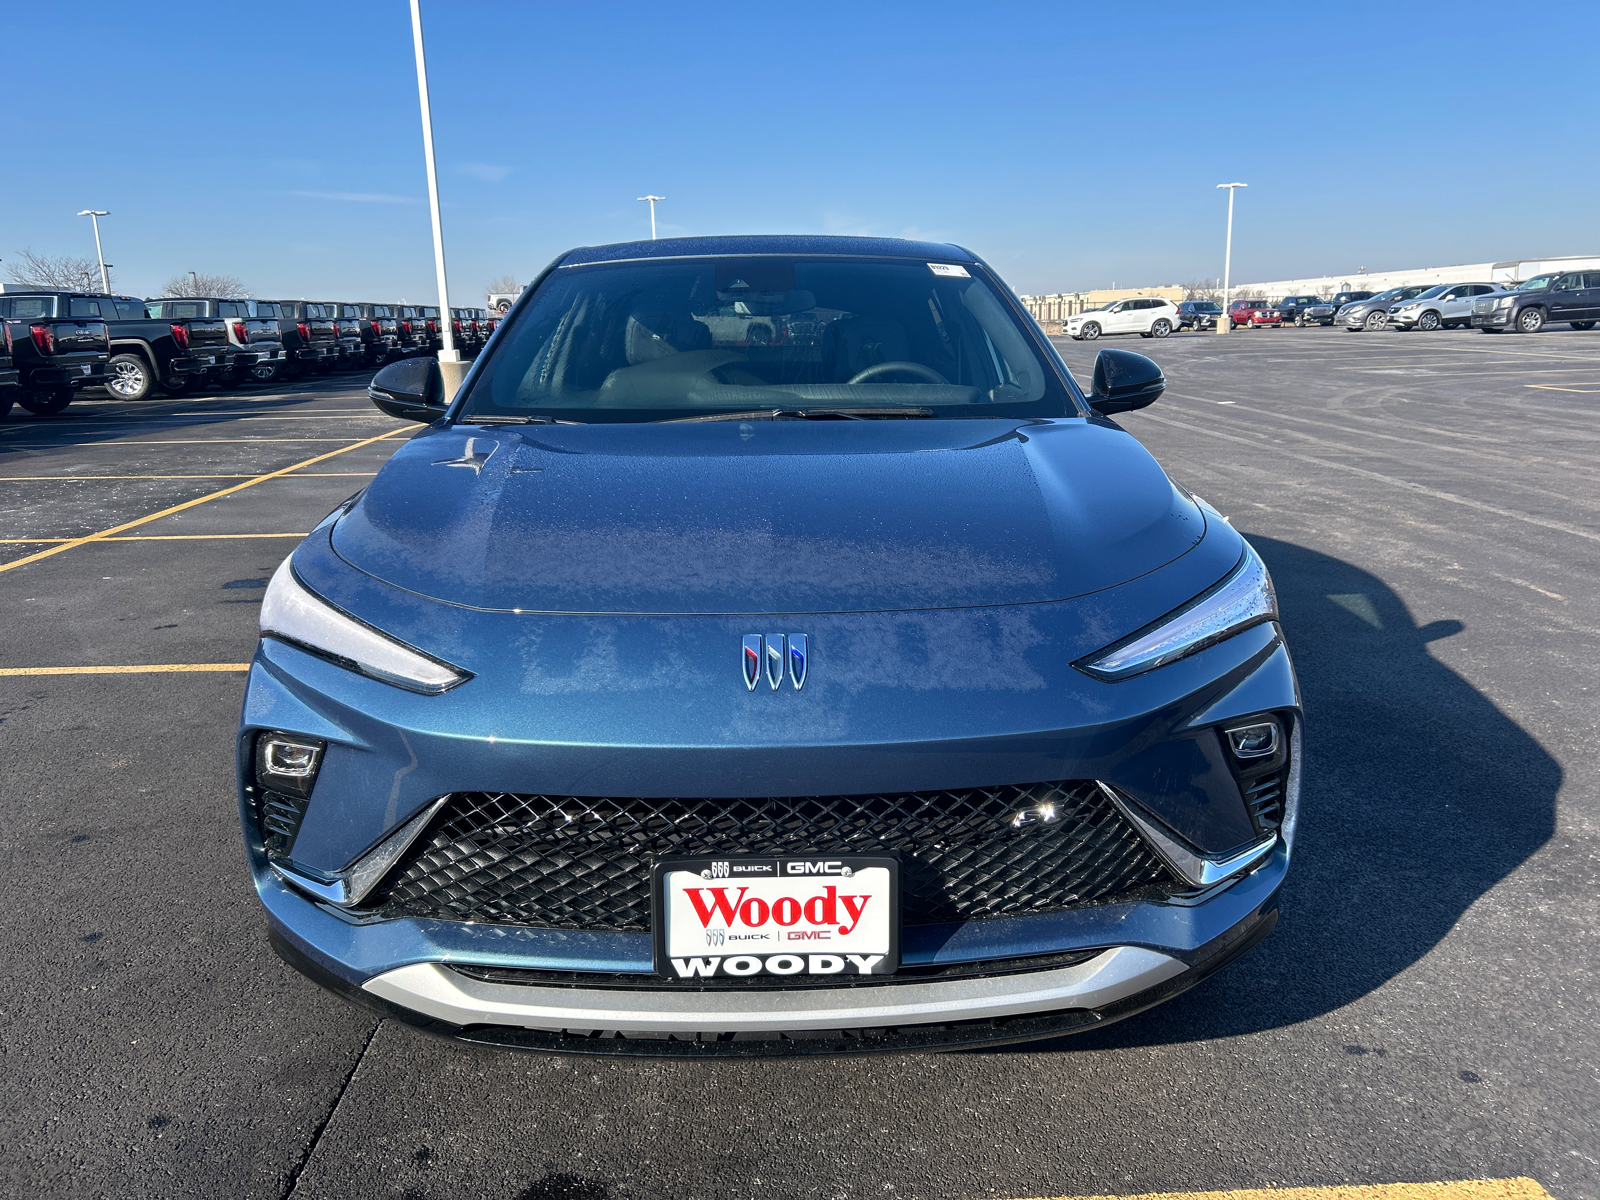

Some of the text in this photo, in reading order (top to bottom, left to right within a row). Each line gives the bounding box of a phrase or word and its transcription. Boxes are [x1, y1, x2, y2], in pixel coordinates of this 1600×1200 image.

[786, 861, 843, 874] GMC
[682, 885, 872, 936] Woody
[728, 930, 832, 941] BUICK GMC
[670, 954, 886, 978] WOODY
